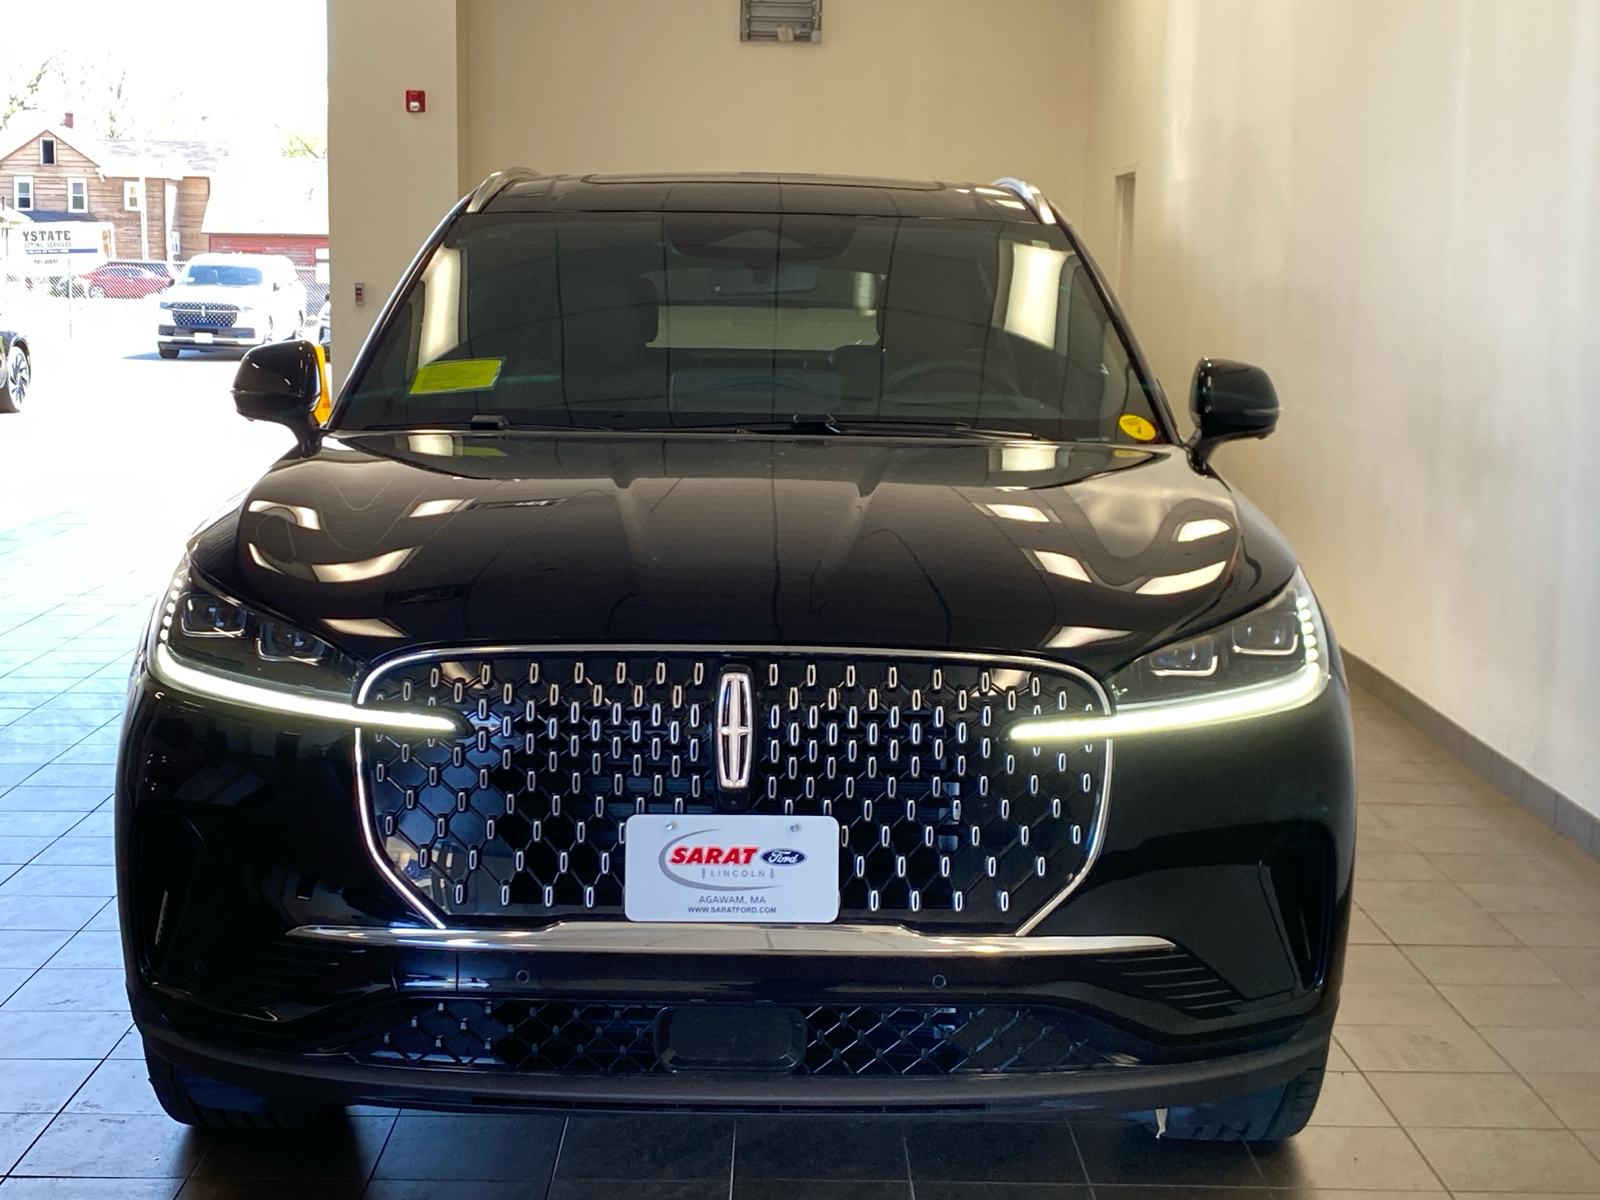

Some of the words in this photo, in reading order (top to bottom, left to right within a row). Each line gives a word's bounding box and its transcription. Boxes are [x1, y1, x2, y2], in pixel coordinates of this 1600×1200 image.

[668, 845, 761, 866] SARAT
[767, 848, 800, 865] Ford
[710, 869, 765, 878] LINCOLN
[698, 896, 747, 905] AGAWAM,
[750, 896, 766, 904] MA
